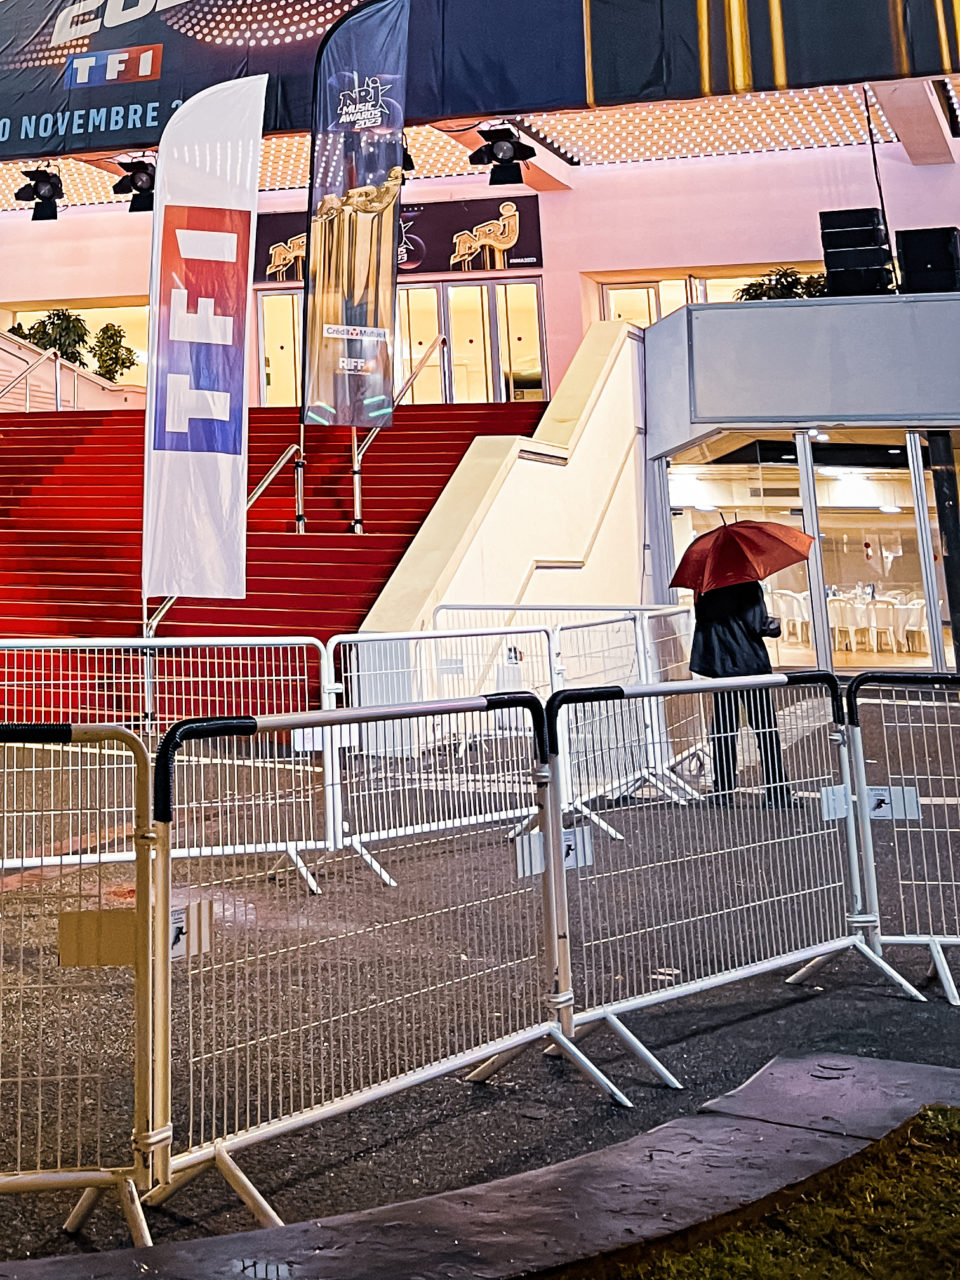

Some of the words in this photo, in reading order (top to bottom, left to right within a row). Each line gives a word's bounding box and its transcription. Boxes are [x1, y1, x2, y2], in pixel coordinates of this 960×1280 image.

[72, 49, 153, 84] TF1
[342, 101, 376, 115] MUSIC
[20, 101, 160, 140] NOVEMBRE
[339, 109, 381, 123] AWARDS
[355, 117, 382, 128] 2023
[164, 227, 239, 434] TF1
[339, 357, 366, 370] RIFF
